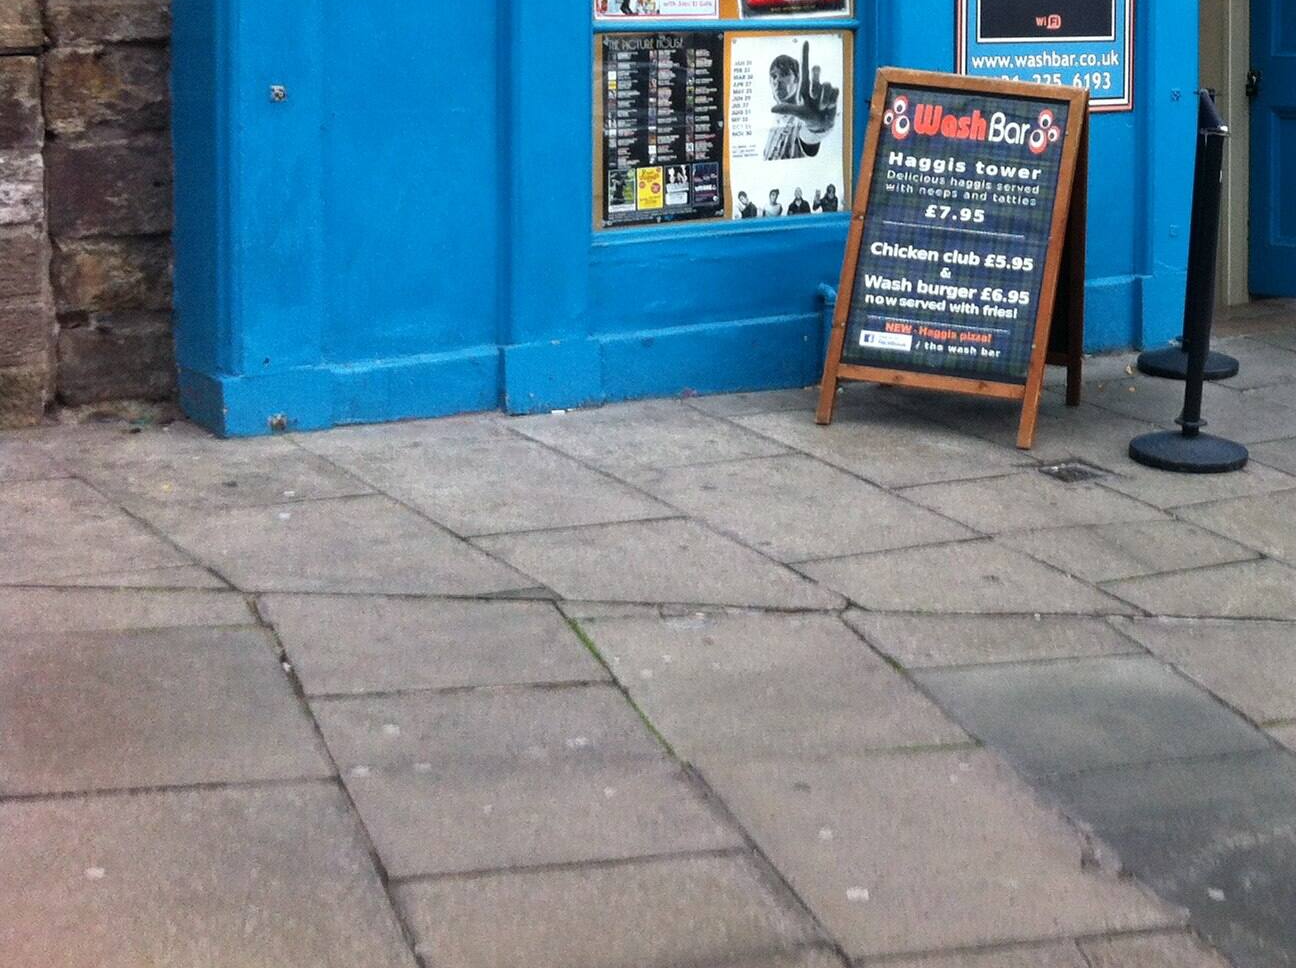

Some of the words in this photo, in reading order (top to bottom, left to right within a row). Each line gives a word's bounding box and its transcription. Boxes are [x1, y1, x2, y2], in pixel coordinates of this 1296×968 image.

[972, 50, 1119, 68] www.washbar.co.uk
[1072, 72, 1111, 91] 6193
[913, 103, 988, 142] Wash
[988, 111, 1031, 145] Bar
[888, 151, 966, 175] Haggis
[975, 159, 1042, 180] tower
[886, 169, 946, 185] Delicious
[950, 176, 992, 191] haggis
[996, 181, 1040, 195] served
[885, 181, 913, 194] with
[919, 187, 958, 200] neeps
[963, 189, 988, 202] and
[992, 193, 1037, 207] tatties
[924, 204, 985, 223] £7.95
[870, 241, 939, 262] Chicken
[943, 249, 980, 266] club
[984, 255, 1034, 272] £5.95
[939, 267, 952, 279] &
[864, 273, 912, 293] Wash
[916, 280, 977, 301] burger
[980, 288, 1030, 305] £6.95
[865, 293, 898, 306] now
[899, 296, 946, 311] served
[949, 301, 980, 316] with
[885, 322, 912, 333] NEW
[918, 325, 957, 340] Haggis
[924, 341, 943, 351] the
[947, 344, 977, 355] wash
[981, 347, 1001, 358] bar
